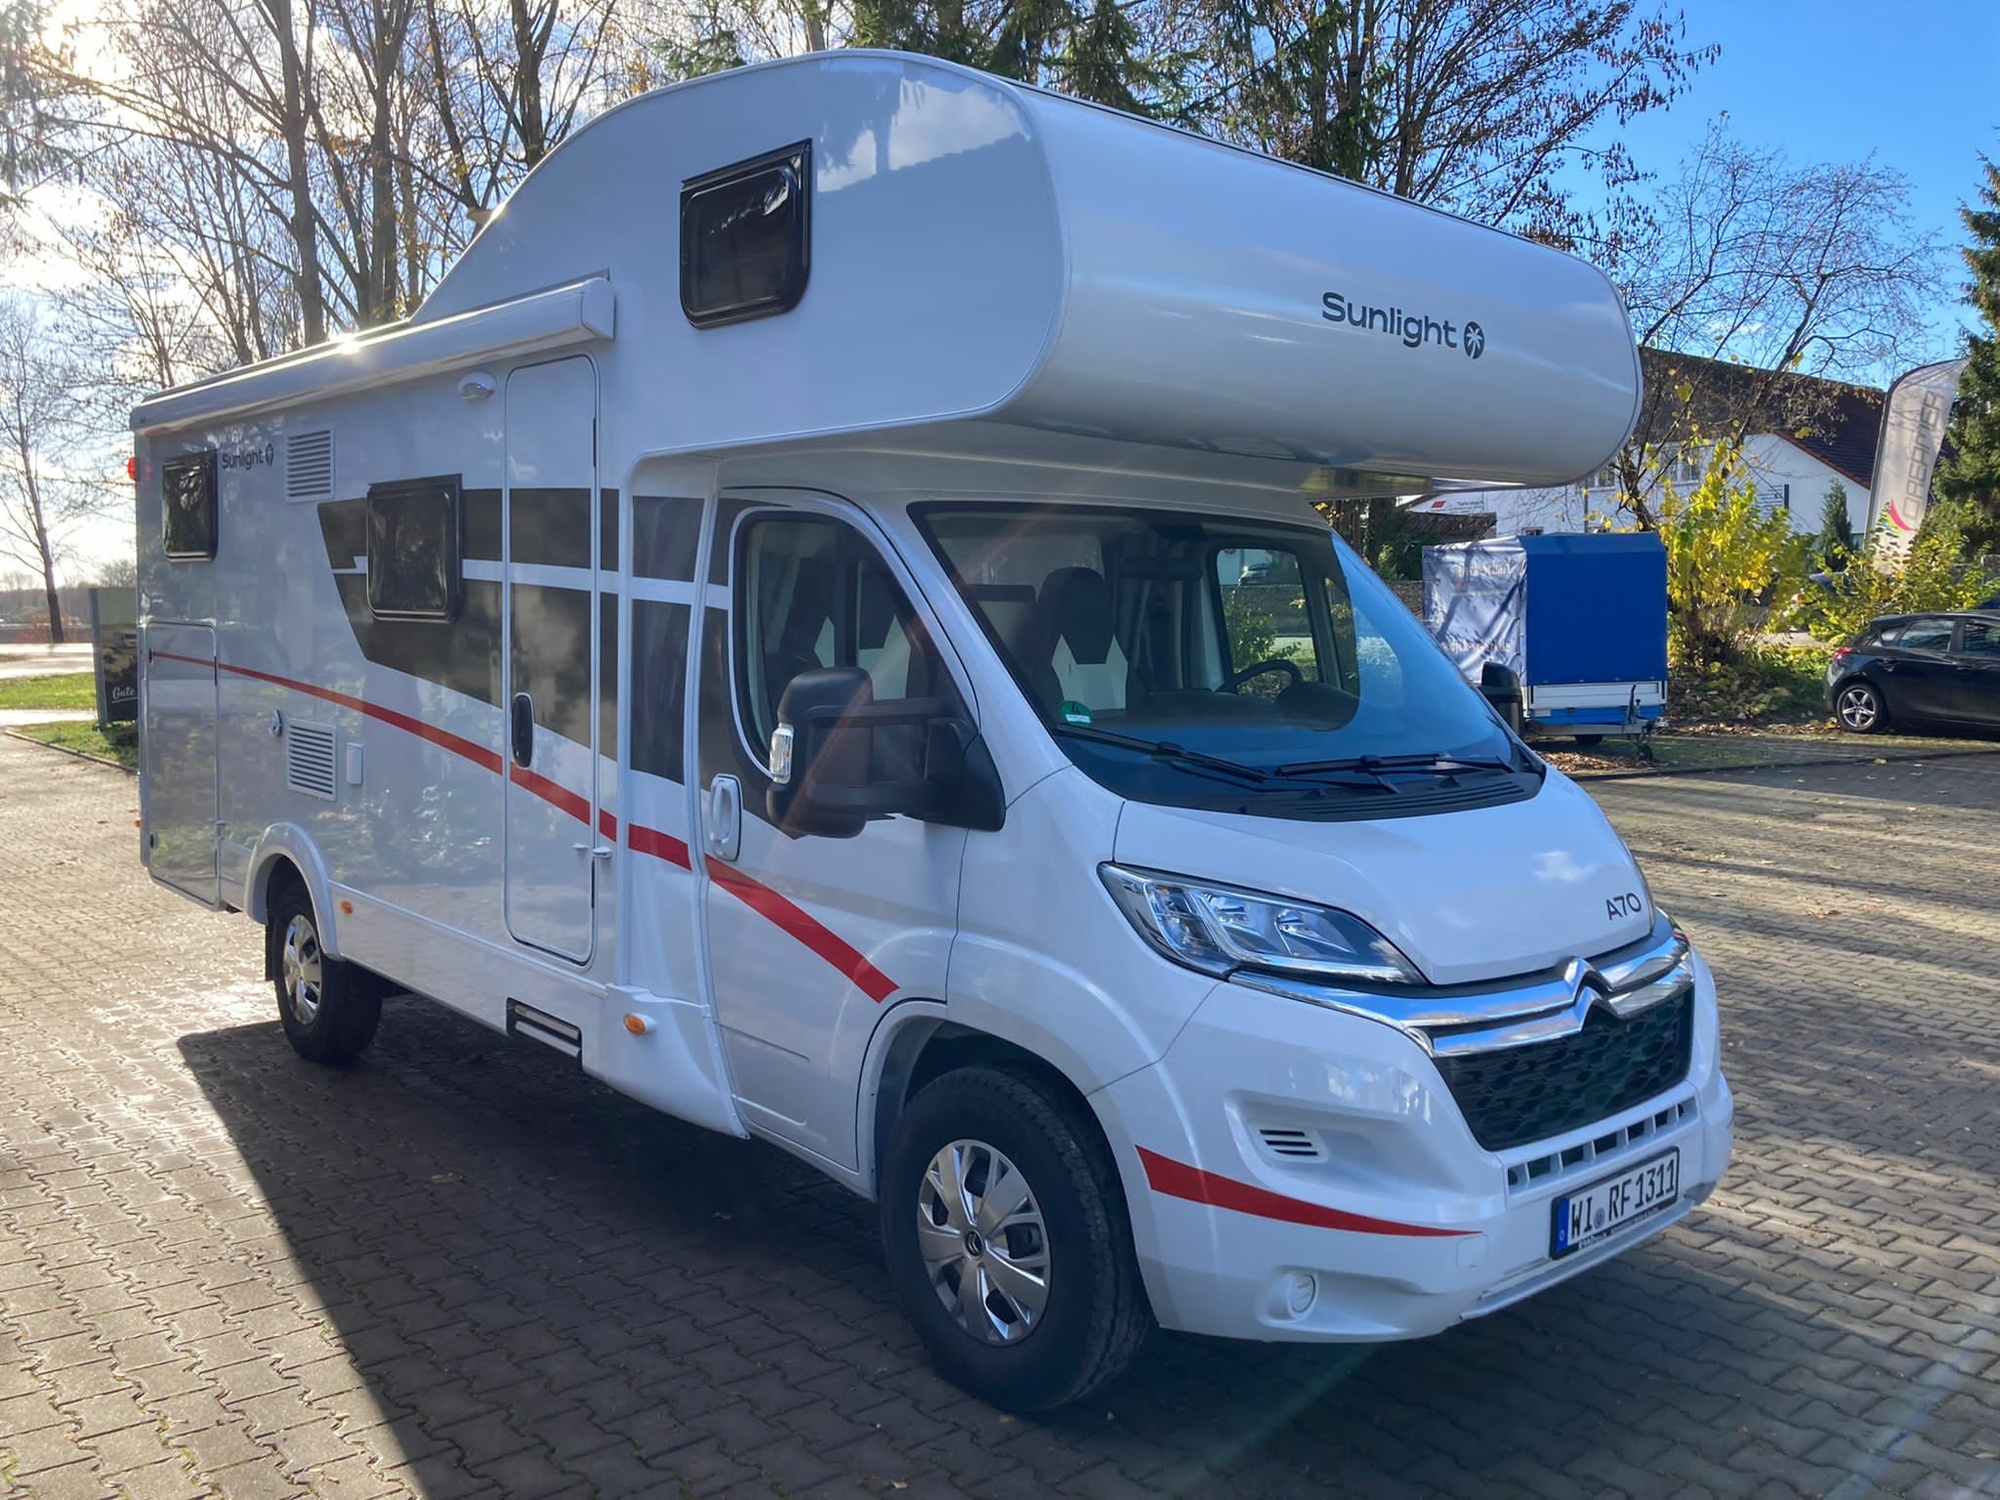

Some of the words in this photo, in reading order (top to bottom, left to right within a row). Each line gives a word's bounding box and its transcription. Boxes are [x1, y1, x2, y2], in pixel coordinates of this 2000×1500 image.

[1322, 292, 1457, 348] Sunlight
[221, 448, 264, 471] Sunlight
[1902, 389, 1945, 519] DREAMER
[1606, 892, 1642, 921] A70
[1571, 1196, 1593, 1239] WI
